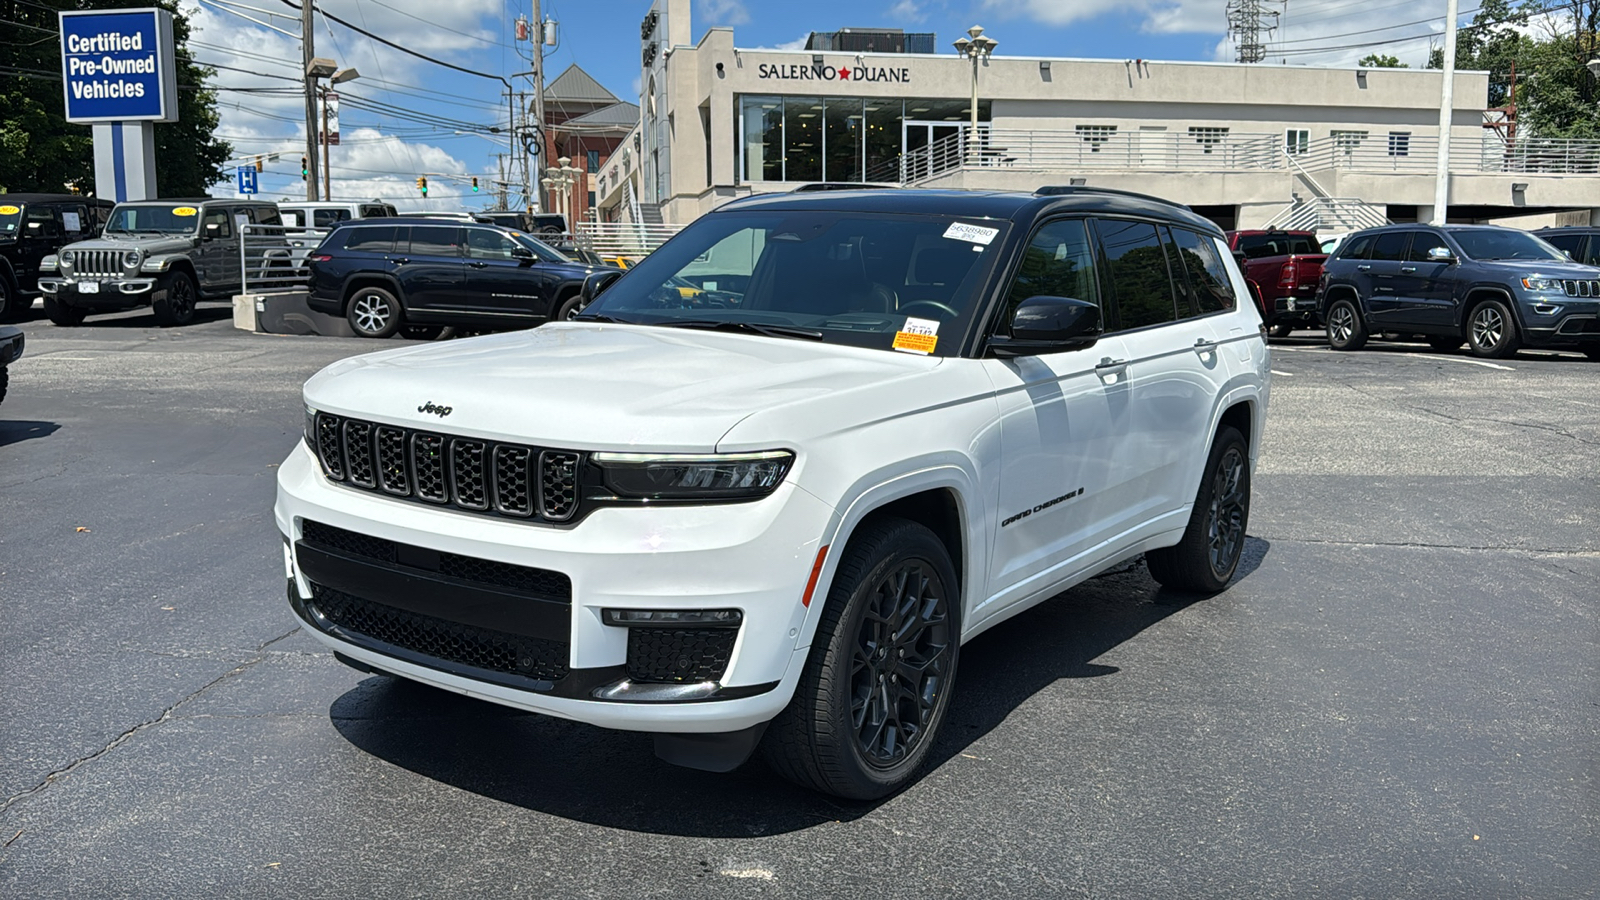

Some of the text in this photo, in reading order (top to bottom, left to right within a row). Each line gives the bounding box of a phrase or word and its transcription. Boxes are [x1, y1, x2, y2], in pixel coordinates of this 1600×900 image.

[68, 31, 142, 53] Certified
[69, 54, 155, 76] Pre-Owned
[758, 63, 911, 83] SALERNO DUANE
[71, 79, 145, 99] Vehicles
[242, 172, 253, 187] H
[950, 224, 993, 237] 5638980
[417, 400, 453, 418] Jeep
[1001, 490, 1077, 528] GRAND CHEROKEE
